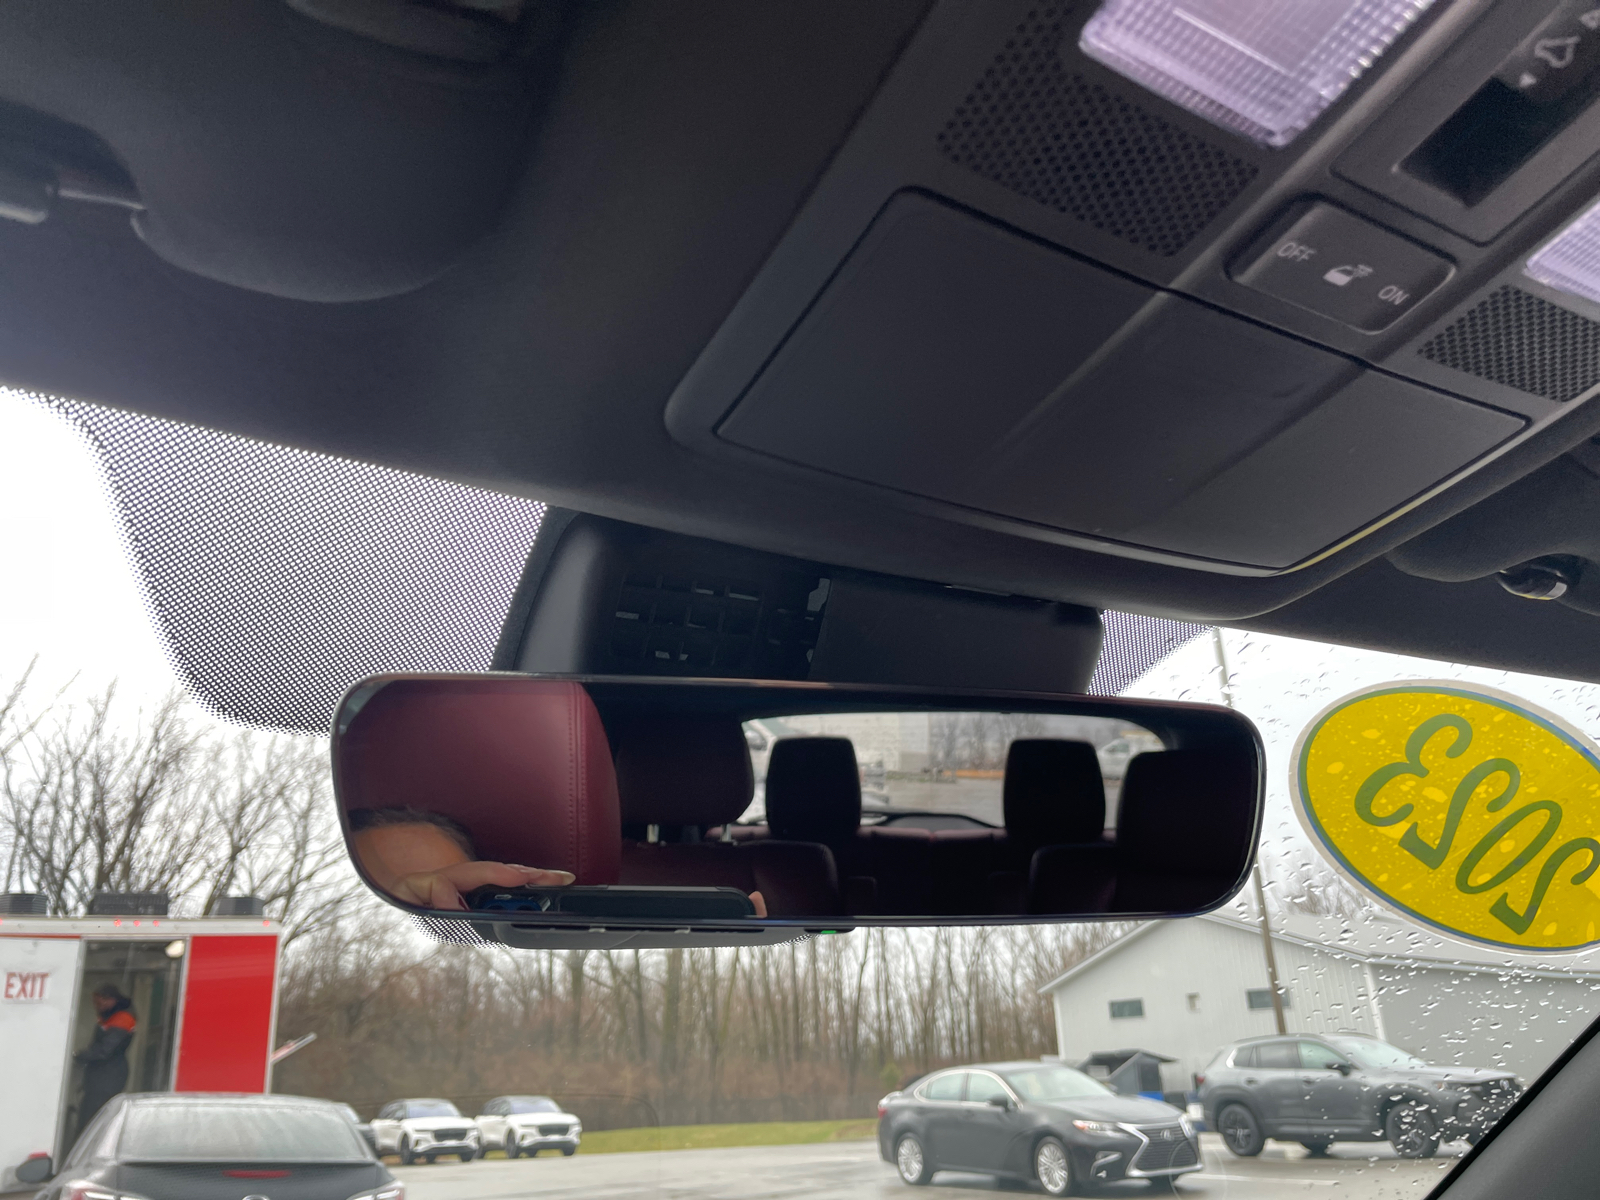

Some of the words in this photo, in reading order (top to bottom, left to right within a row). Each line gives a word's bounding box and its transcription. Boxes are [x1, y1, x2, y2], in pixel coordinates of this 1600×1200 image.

[1277, 242, 1317, 262] OFF
[1377, 285, 1410, 305] ON
[4, 971, 51, 999] EXIT
